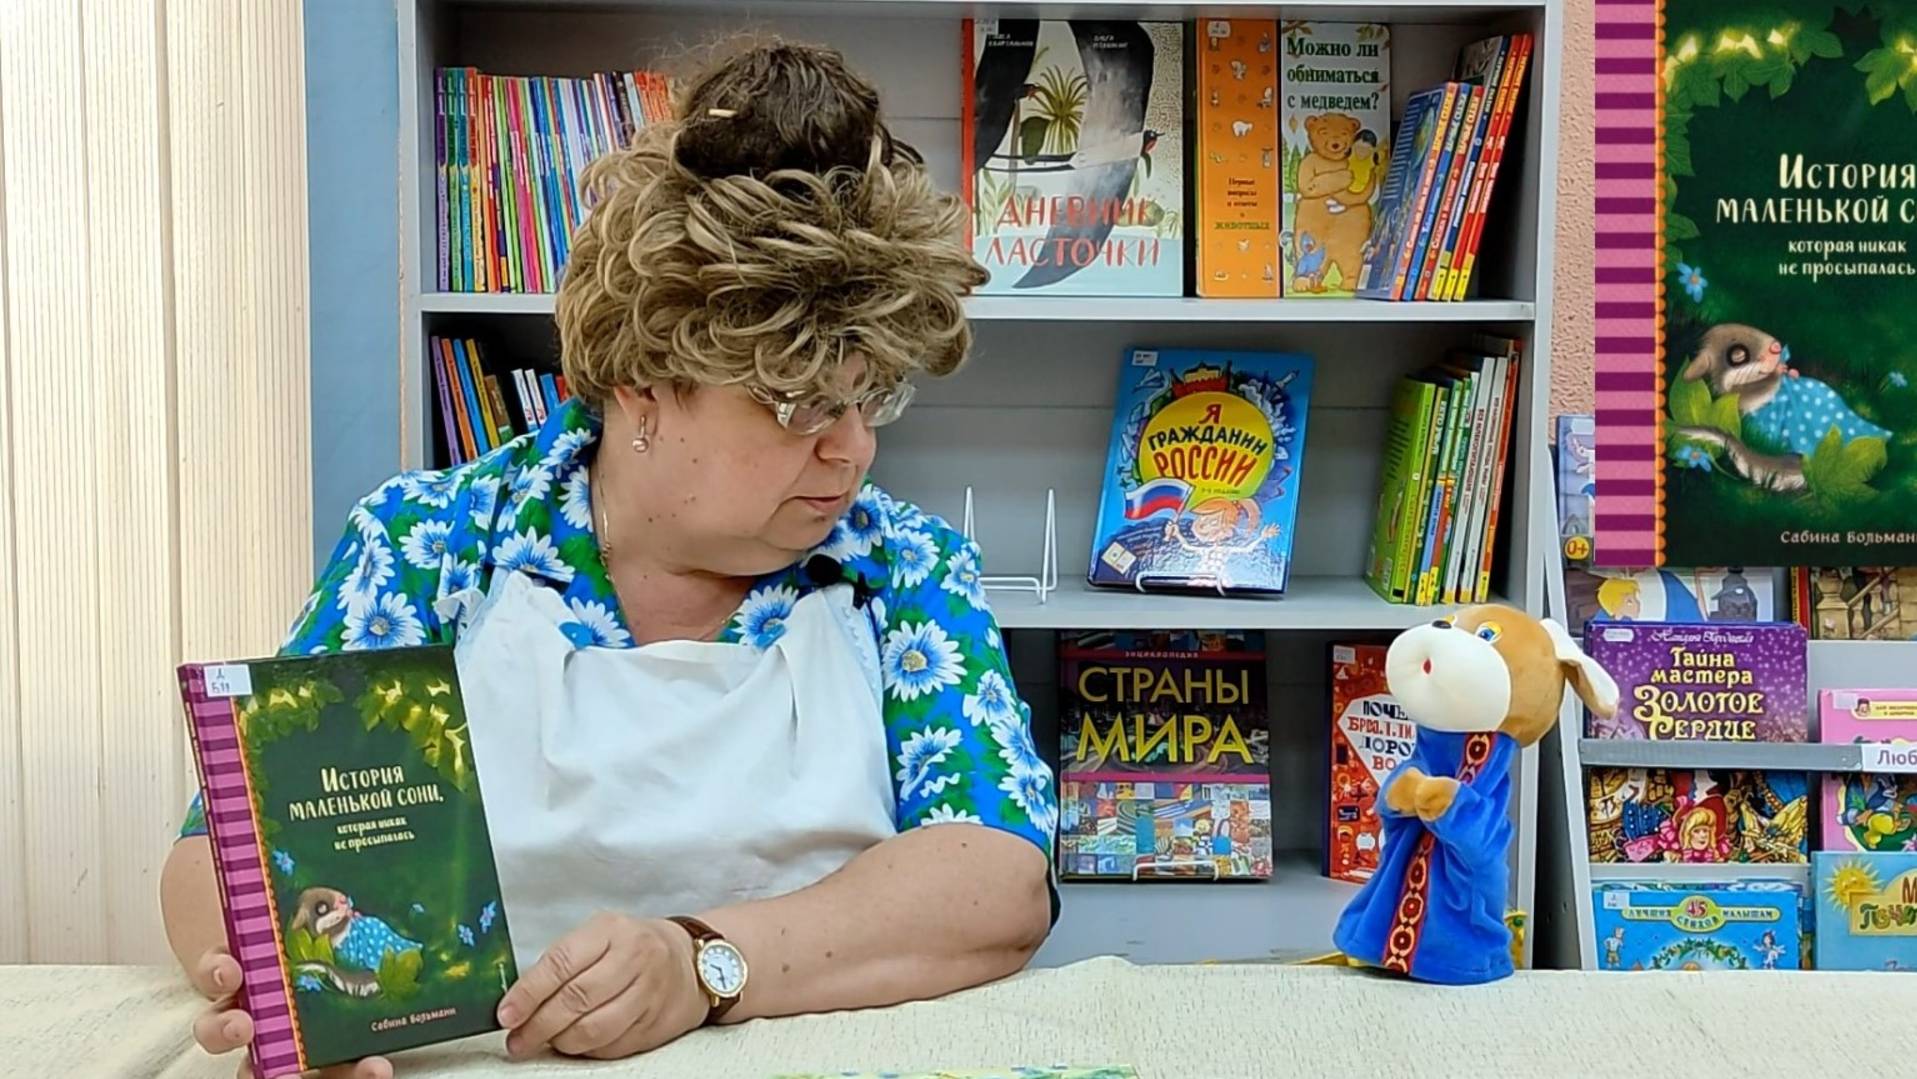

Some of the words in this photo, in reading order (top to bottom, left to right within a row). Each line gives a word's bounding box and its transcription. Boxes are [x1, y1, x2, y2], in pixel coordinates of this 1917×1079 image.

[1286, 37, 1351, 58] Можно
[1355, 43, 1379, 57] ли
[1286, 65, 1380, 83] обниматься
[1287, 95, 1295, 108] с
[1301, 92, 1380, 111] медведем?
[996, 194, 1152, 227] ДНЕВНИК
[985, 237, 1161, 267] ЛАСТОЧКИ
[1198, 403, 1222, 425] Я
[1147, 425, 1268, 456] ГРАЖДАНИН
[1152, 445, 1258, 488] РОССИИ
[1670, 647, 1735, 667] Тайна
[1078, 666, 1250, 705] СТРАНЫ
[1650, 669, 1753, 688] мастера
[1363, 700, 1408, 720] ПОЧЕ
[1076, 711, 1255, 765] МИРА
[1358, 735, 1415, 757] ДОРО
[1372, 755, 1397, 771] ВО
[1877, 749, 1917, 766] Люб
[288, 788, 393, 821] МАЛЕНЬКОЙ
[336, 820, 377, 836] которая
[1686, 899, 1708, 918] 45
